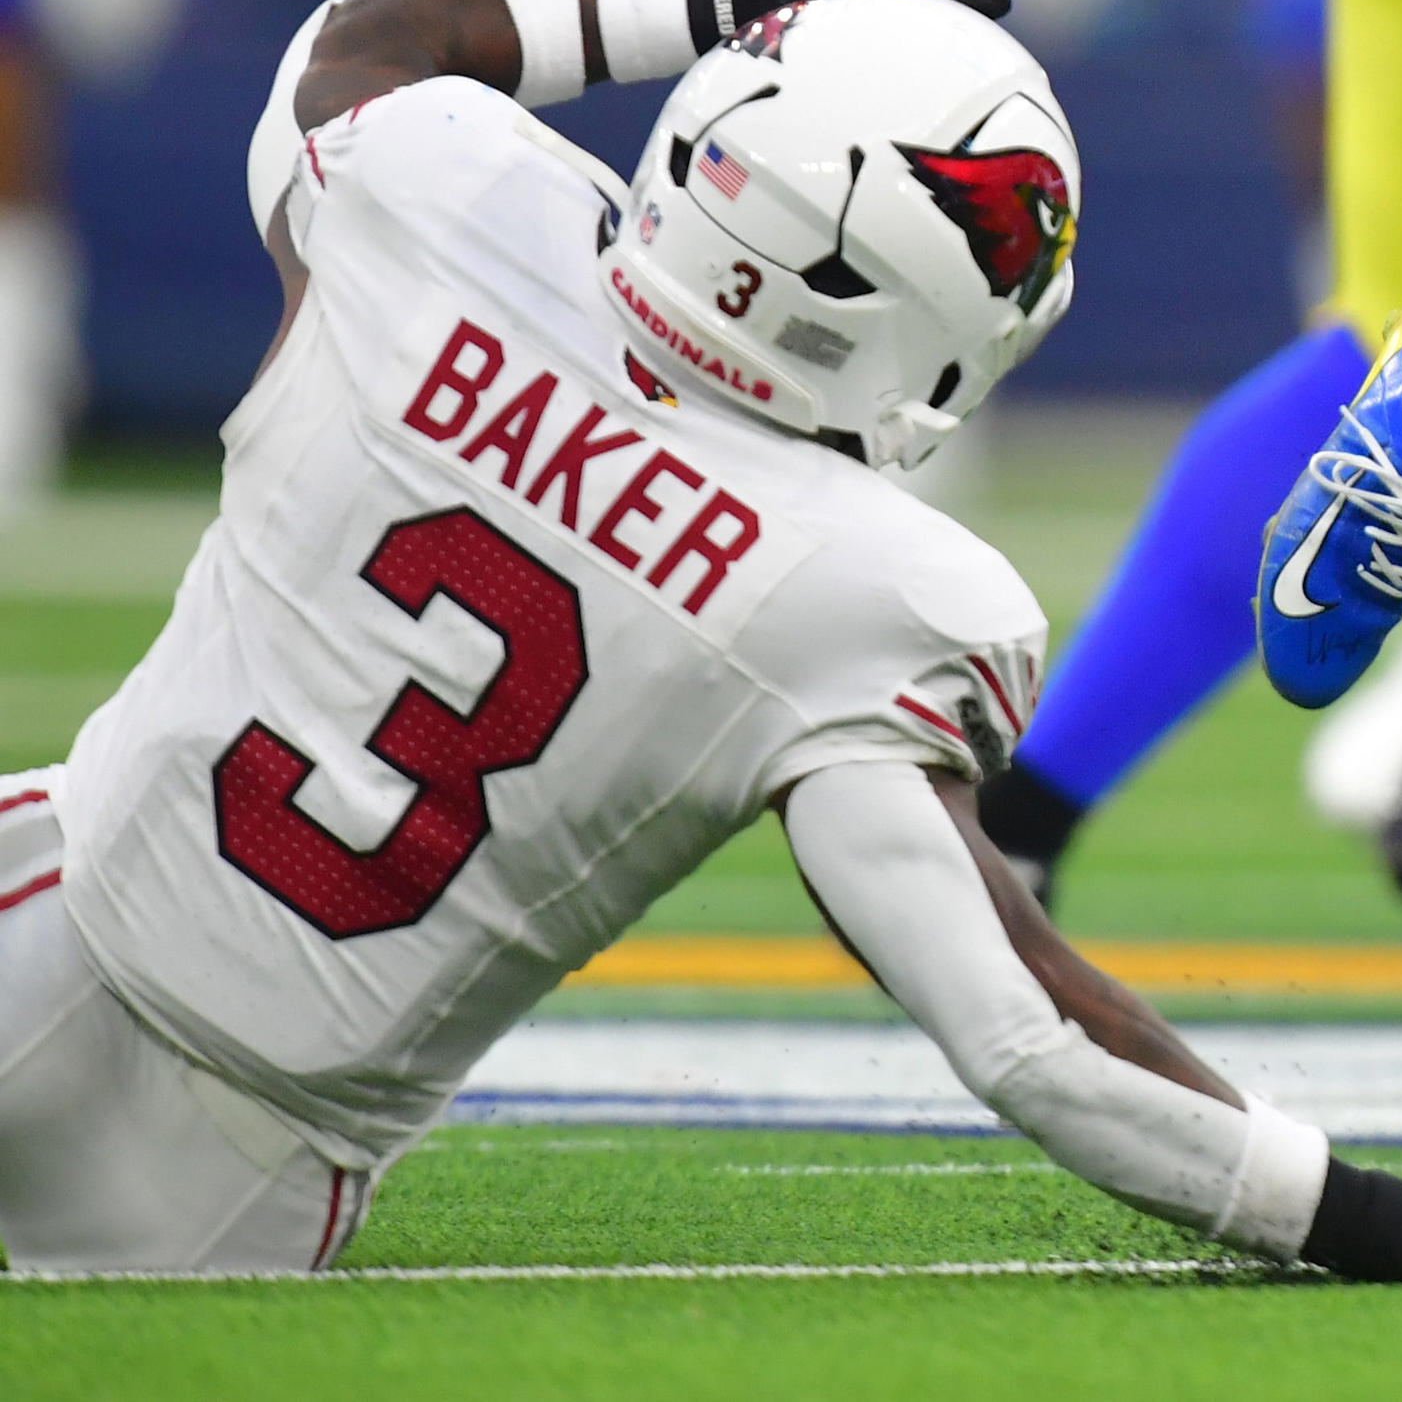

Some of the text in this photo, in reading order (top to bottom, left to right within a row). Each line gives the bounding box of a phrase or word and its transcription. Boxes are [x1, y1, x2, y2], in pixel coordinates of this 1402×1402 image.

[611, 267, 774, 401] CARDINALS
[716, 259, 762, 318] 3
[401, 317, 761, 617] BAKER
[212, 505, 589, 940] 3
